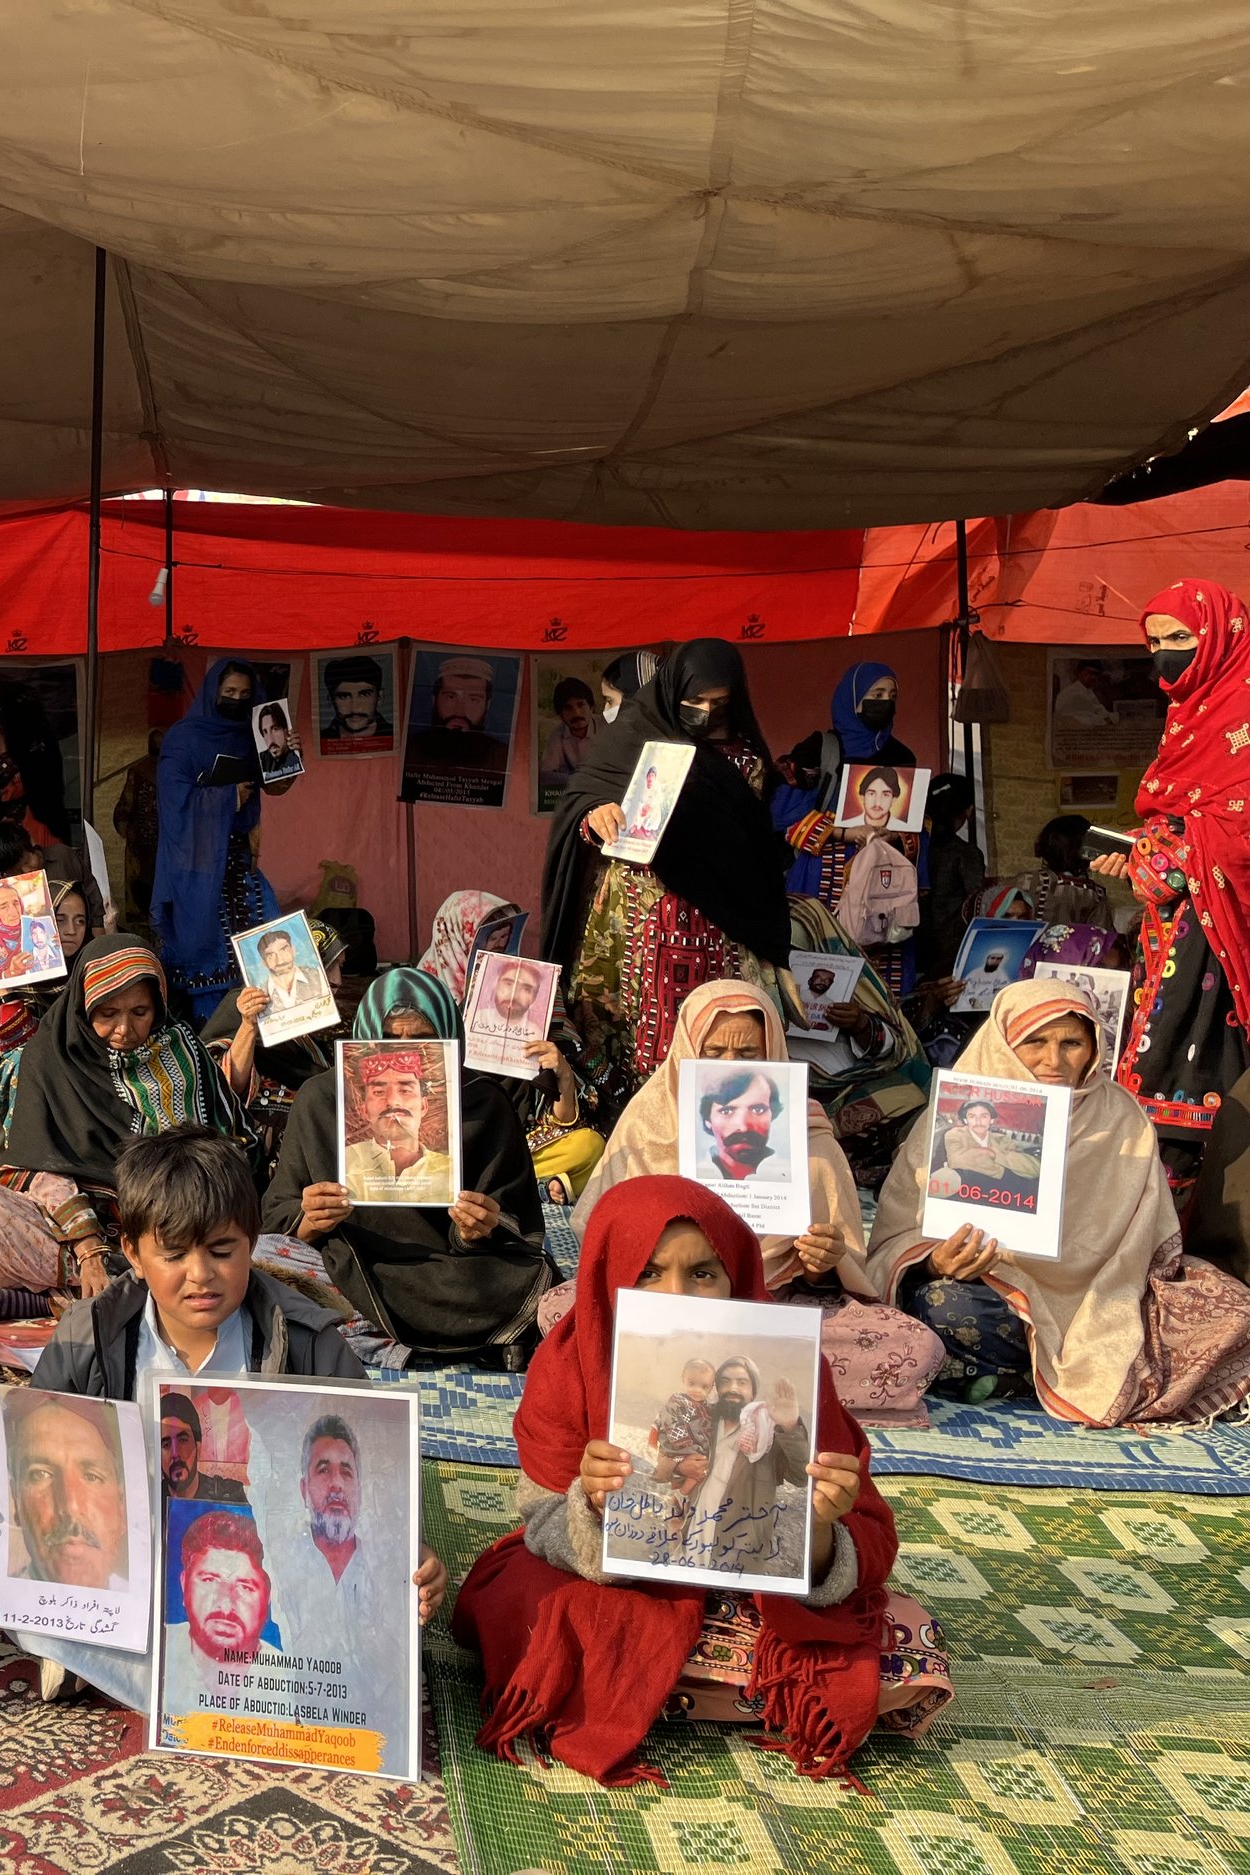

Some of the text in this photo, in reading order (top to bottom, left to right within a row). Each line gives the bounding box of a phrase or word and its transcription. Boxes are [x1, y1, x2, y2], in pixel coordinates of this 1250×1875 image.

[416, 779, 445, 787] Abducted
[446, 781, 463, 789] From
[697, 1497, 734, 1526] محمد
[38, 1595, 56, 1606] بلوچ
[82, 1600, 100, 1612] افراد
[3, 1613, 64, 1628] 11-2-2013
[65, 1616, 86, 1631] تاریخ
[306, 1657, 342, 1675] YAQOOB
[218, 1671, 240, 1688] DATE
[243, 1675, 254, 1689] OF
[199, 1694, 226, 1709] PLACE
[230, 1697, 241, 1711] OF
[332, 1708, 367, 1726] WINDER
[212, 1718, 356, 1750] #ReleaseMuhammadYaqoob
